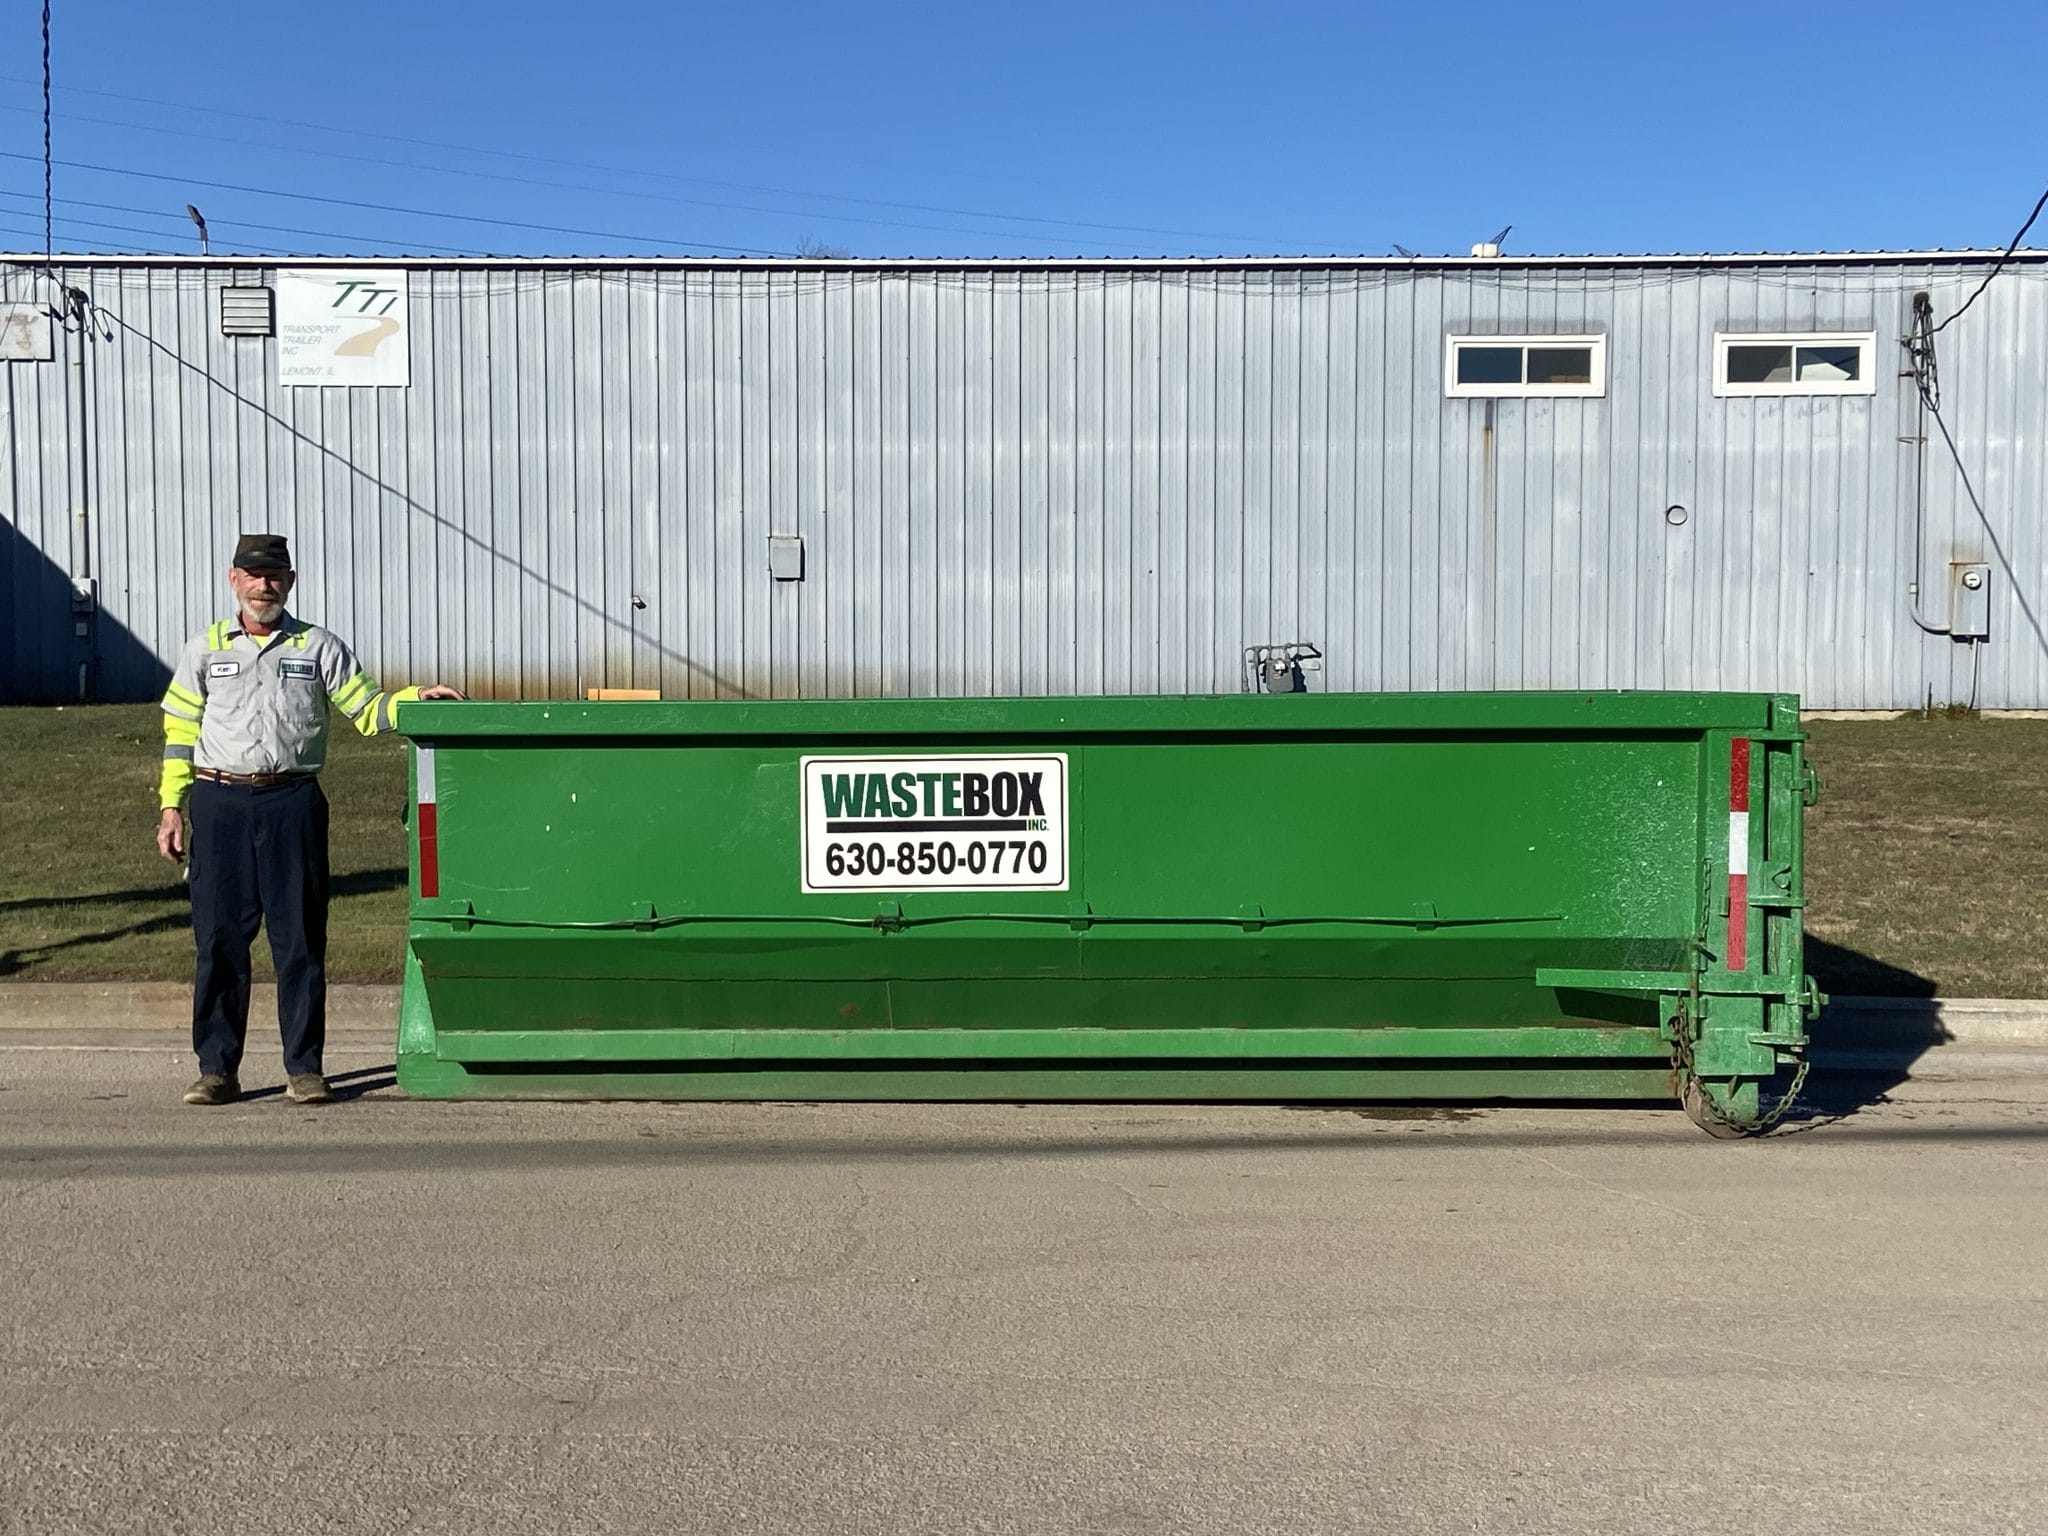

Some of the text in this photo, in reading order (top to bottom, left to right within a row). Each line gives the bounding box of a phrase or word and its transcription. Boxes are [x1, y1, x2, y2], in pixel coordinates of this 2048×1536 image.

[332, 281, 398, 315] TTI
[283, 325, 341, 334] TRANSPORT
[283, 336, 321, 344] TRAILER
[821, 771, 1045, 818] WASTEBOX
[1028, 819, 1049, 831] INC.
[826, 840, 1047, 876] 630-850-0770
